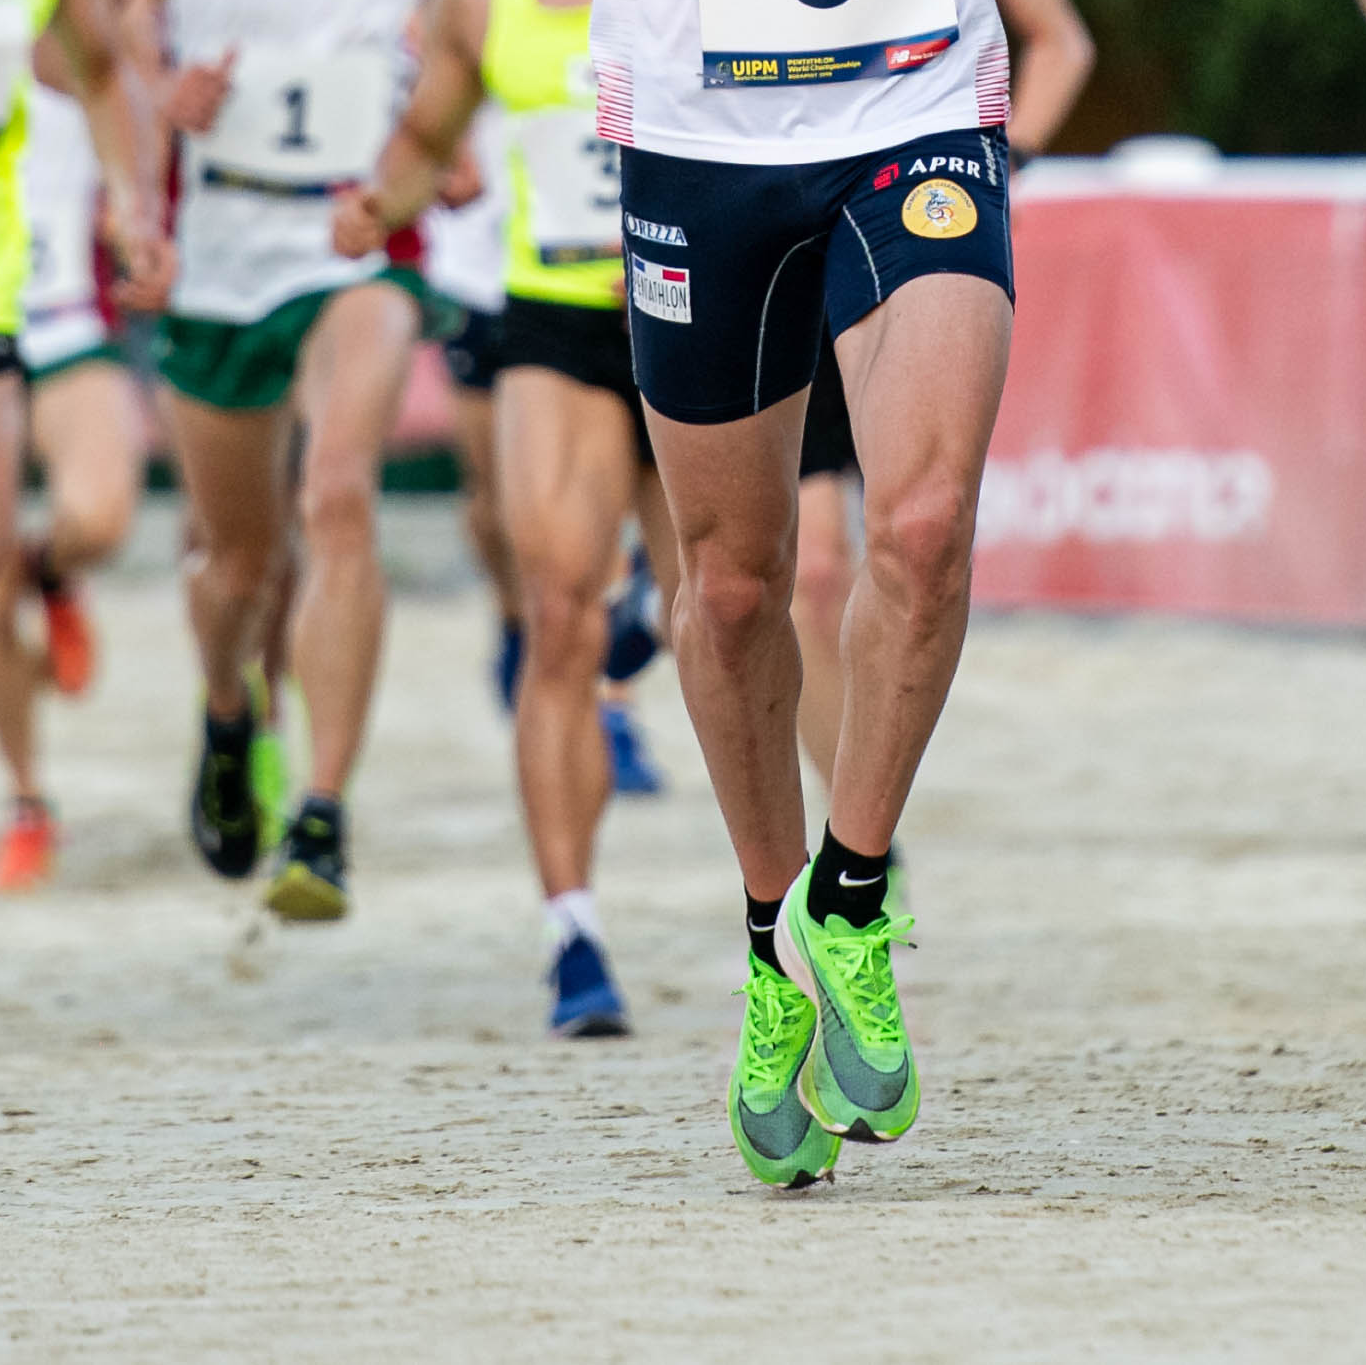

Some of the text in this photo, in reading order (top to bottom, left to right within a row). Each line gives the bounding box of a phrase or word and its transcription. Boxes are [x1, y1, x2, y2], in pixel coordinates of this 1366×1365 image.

[732, 59, 779, 76] UIPM
[276, 84, 317, 150] 1
[908, 157, 981, 179] APRR
[625, 213, 686, 244] OREZZA
